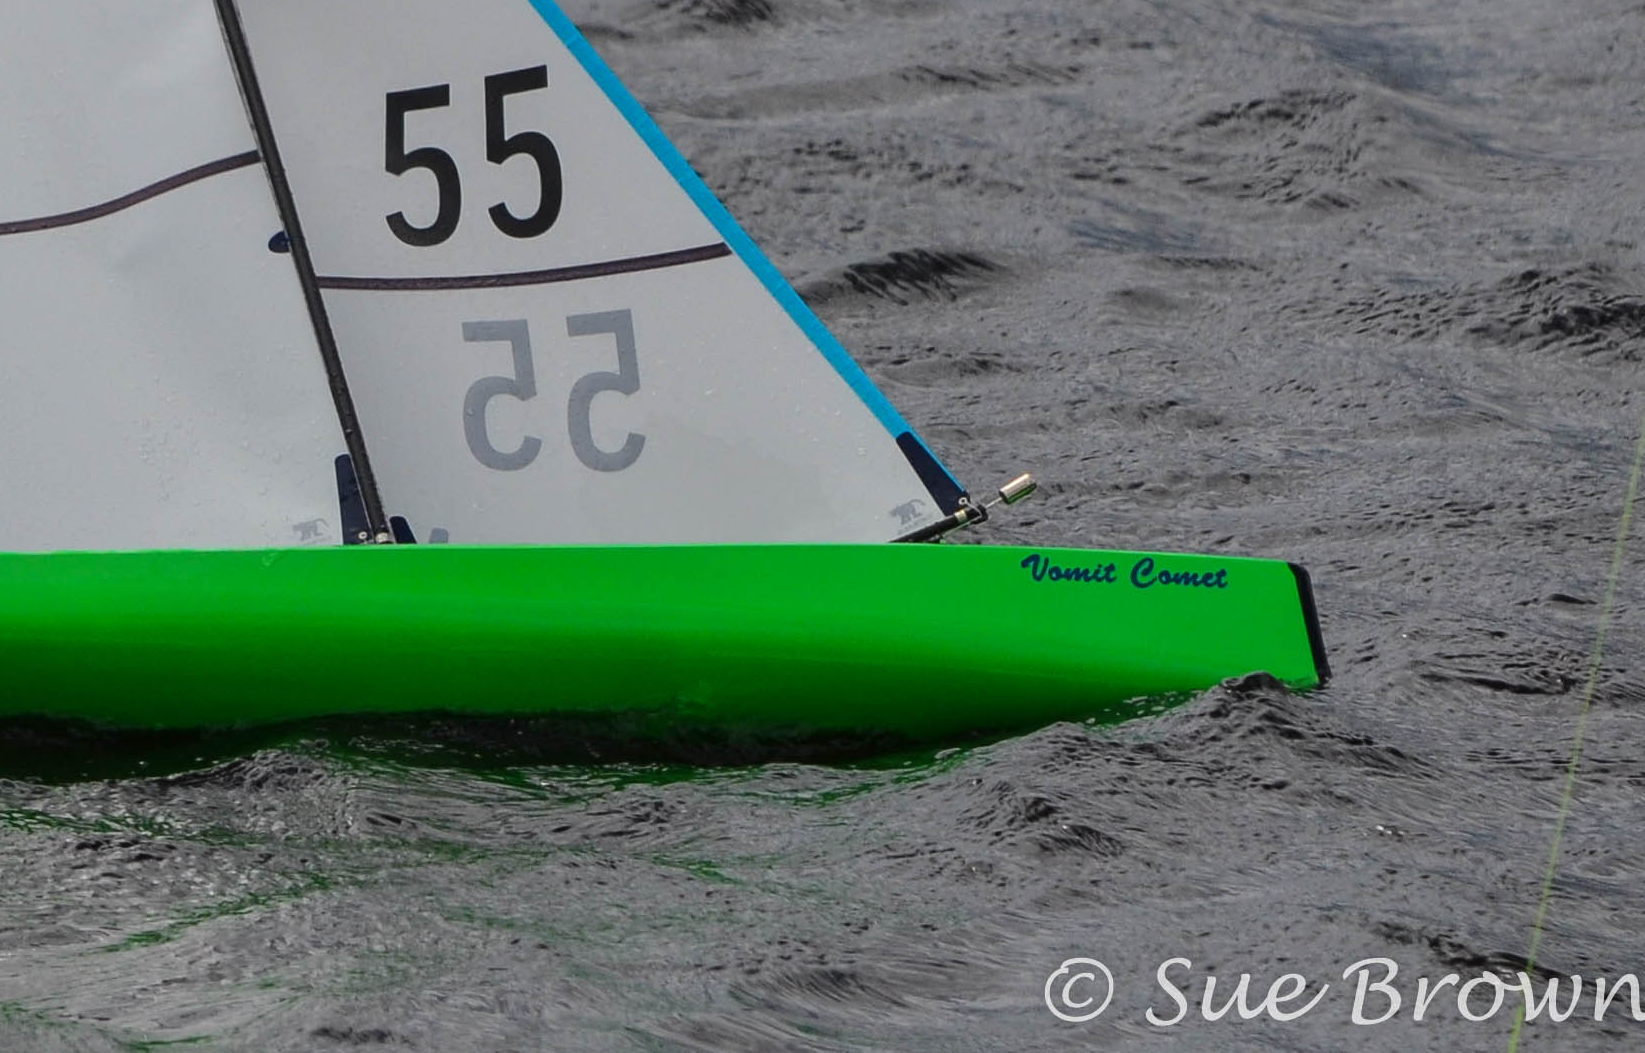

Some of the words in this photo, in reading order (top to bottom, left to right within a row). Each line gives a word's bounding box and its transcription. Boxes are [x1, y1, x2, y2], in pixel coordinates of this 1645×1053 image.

[385, 64, 563, 247] 55
[1020, 553, 1117, 583] Vomit
[1130, 557, 1228, 589] Comet
